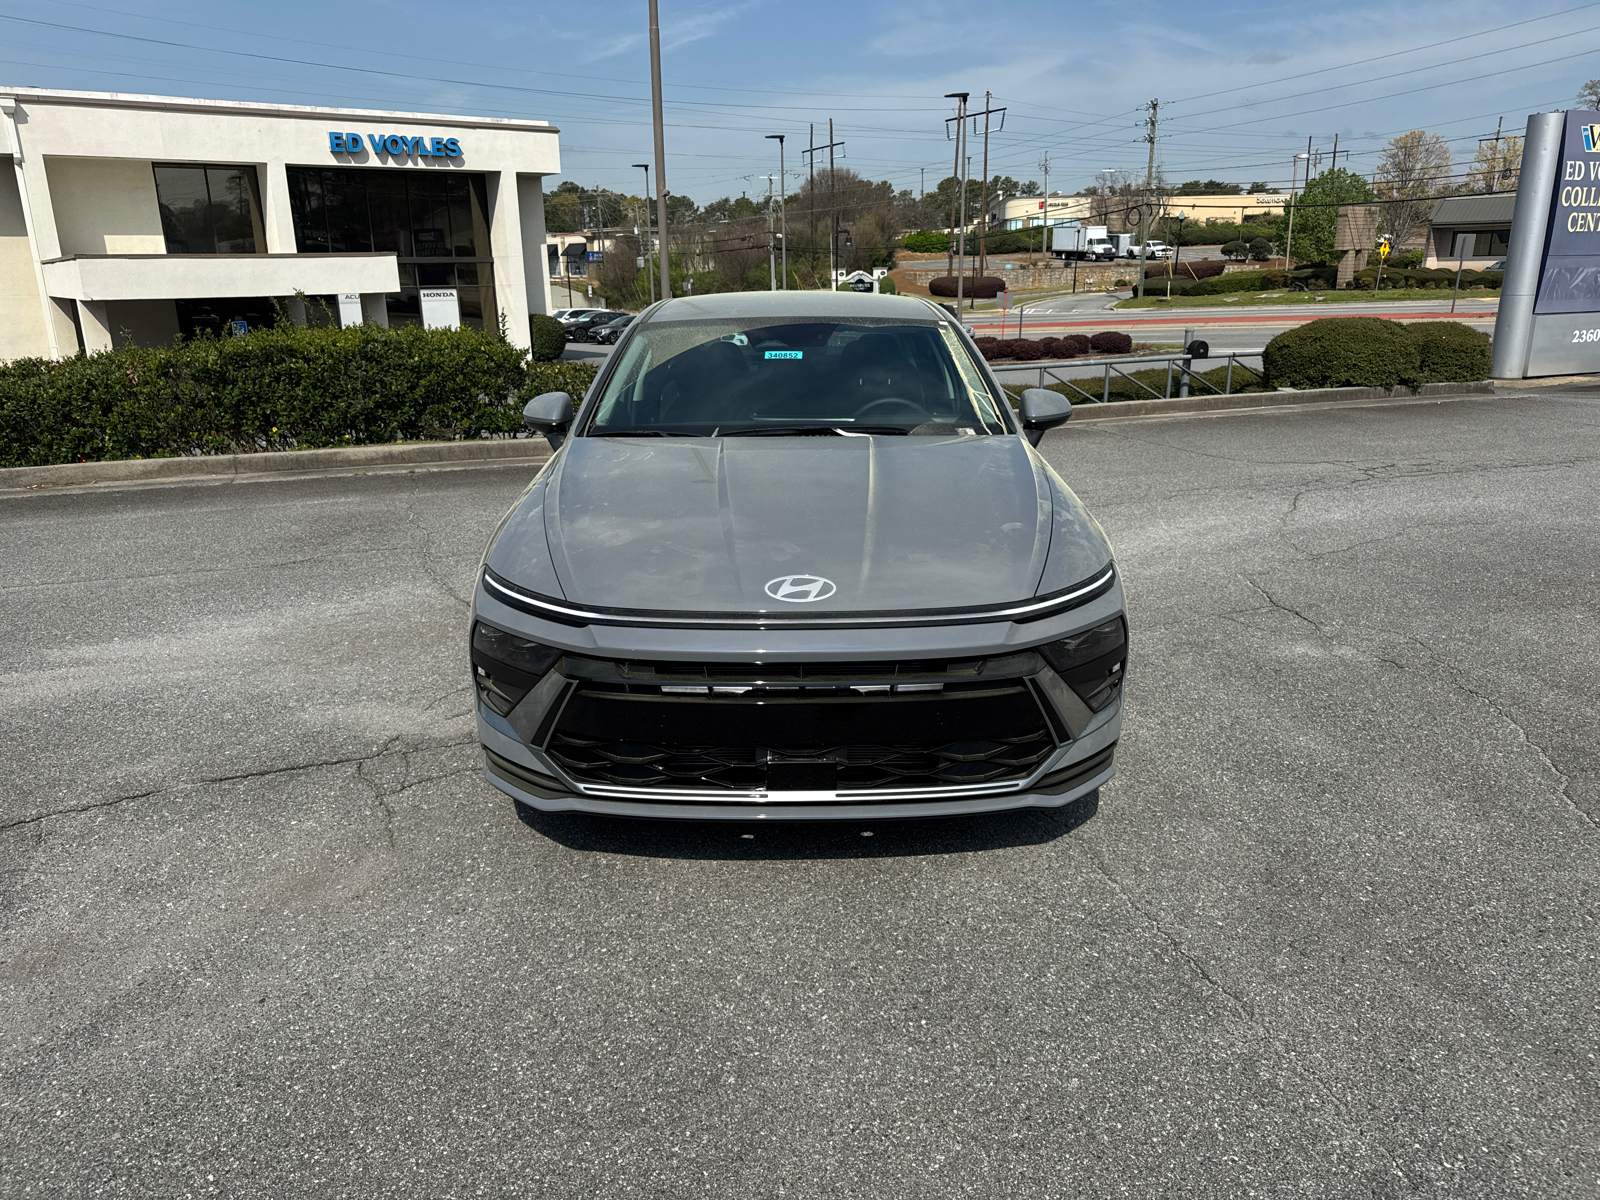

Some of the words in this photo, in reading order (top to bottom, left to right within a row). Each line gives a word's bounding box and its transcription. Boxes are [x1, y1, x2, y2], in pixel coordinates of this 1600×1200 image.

[328, 131, 364, 153] ED
[367, 133, 462, 157] VOYLES
[1564, 160, 1586, 181] ED
[1588, 161, 1600, 182] V
[1571, 328, 1600, 343] 2360
